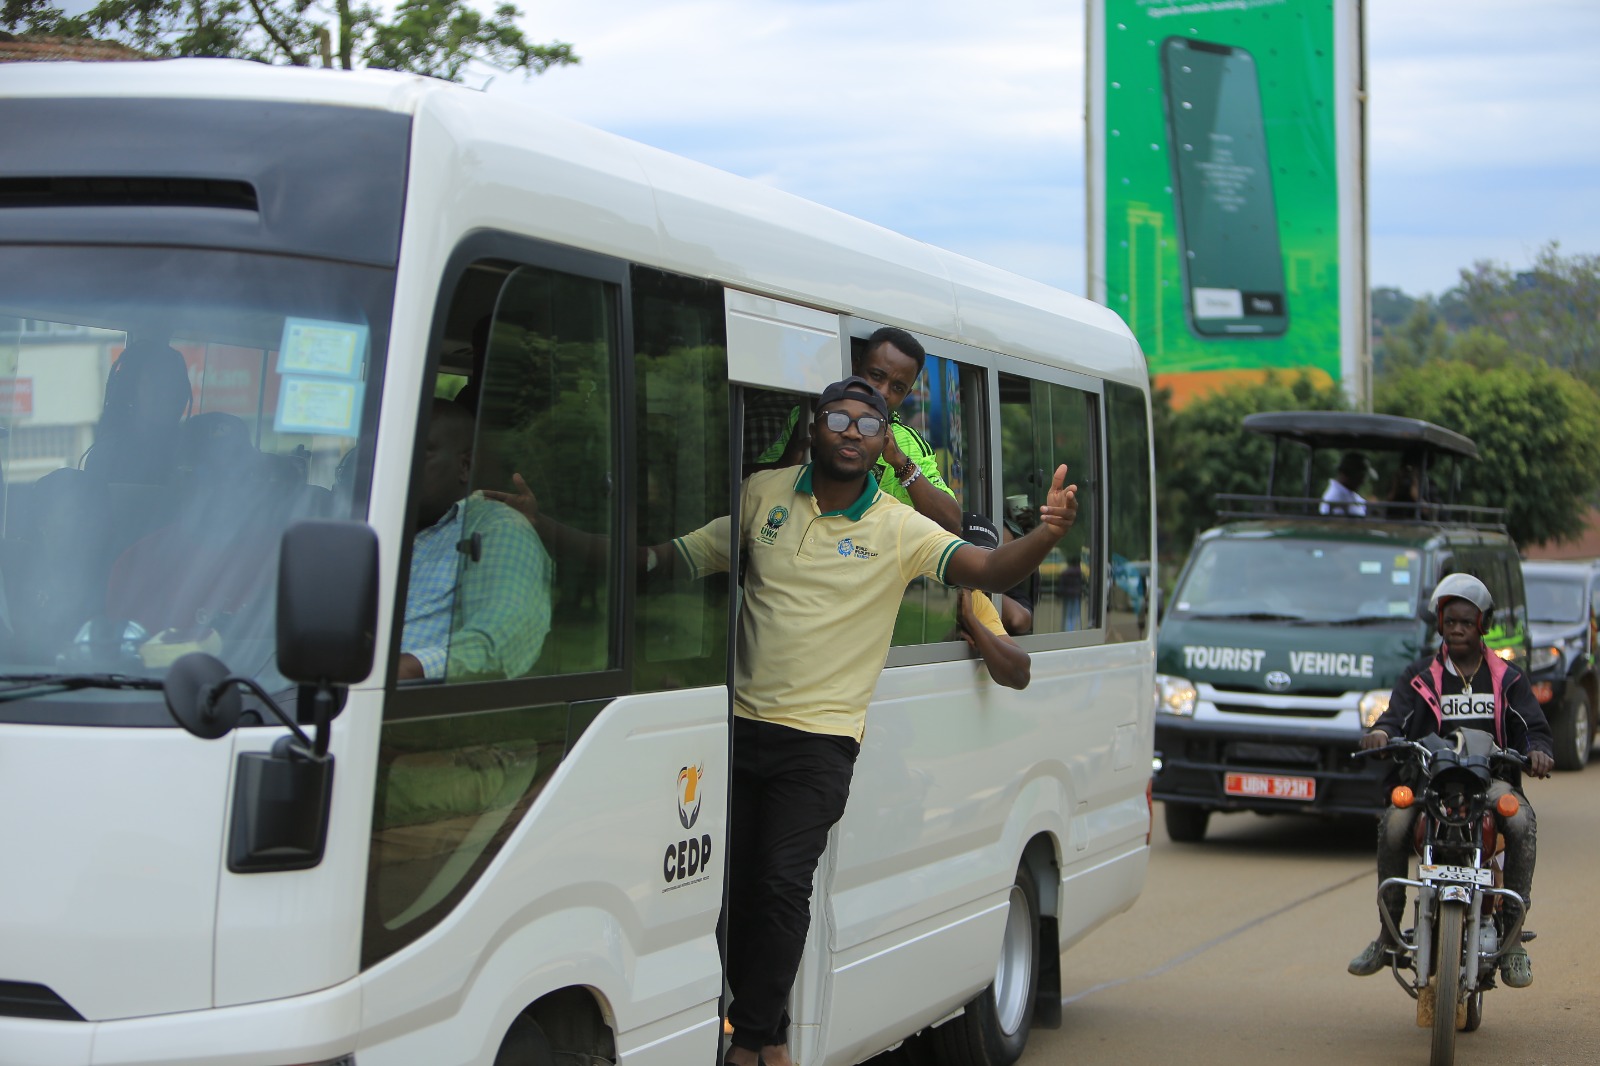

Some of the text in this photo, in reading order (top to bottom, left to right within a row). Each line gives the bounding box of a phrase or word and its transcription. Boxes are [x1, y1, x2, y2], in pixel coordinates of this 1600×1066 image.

[760, 526, 778, 539] UWA
[1183, 646, 1374, 677] TOURIST VEHICLE
[1441, 697, 1495, 716] didas
[663, 833, 711, 883] CEDP
